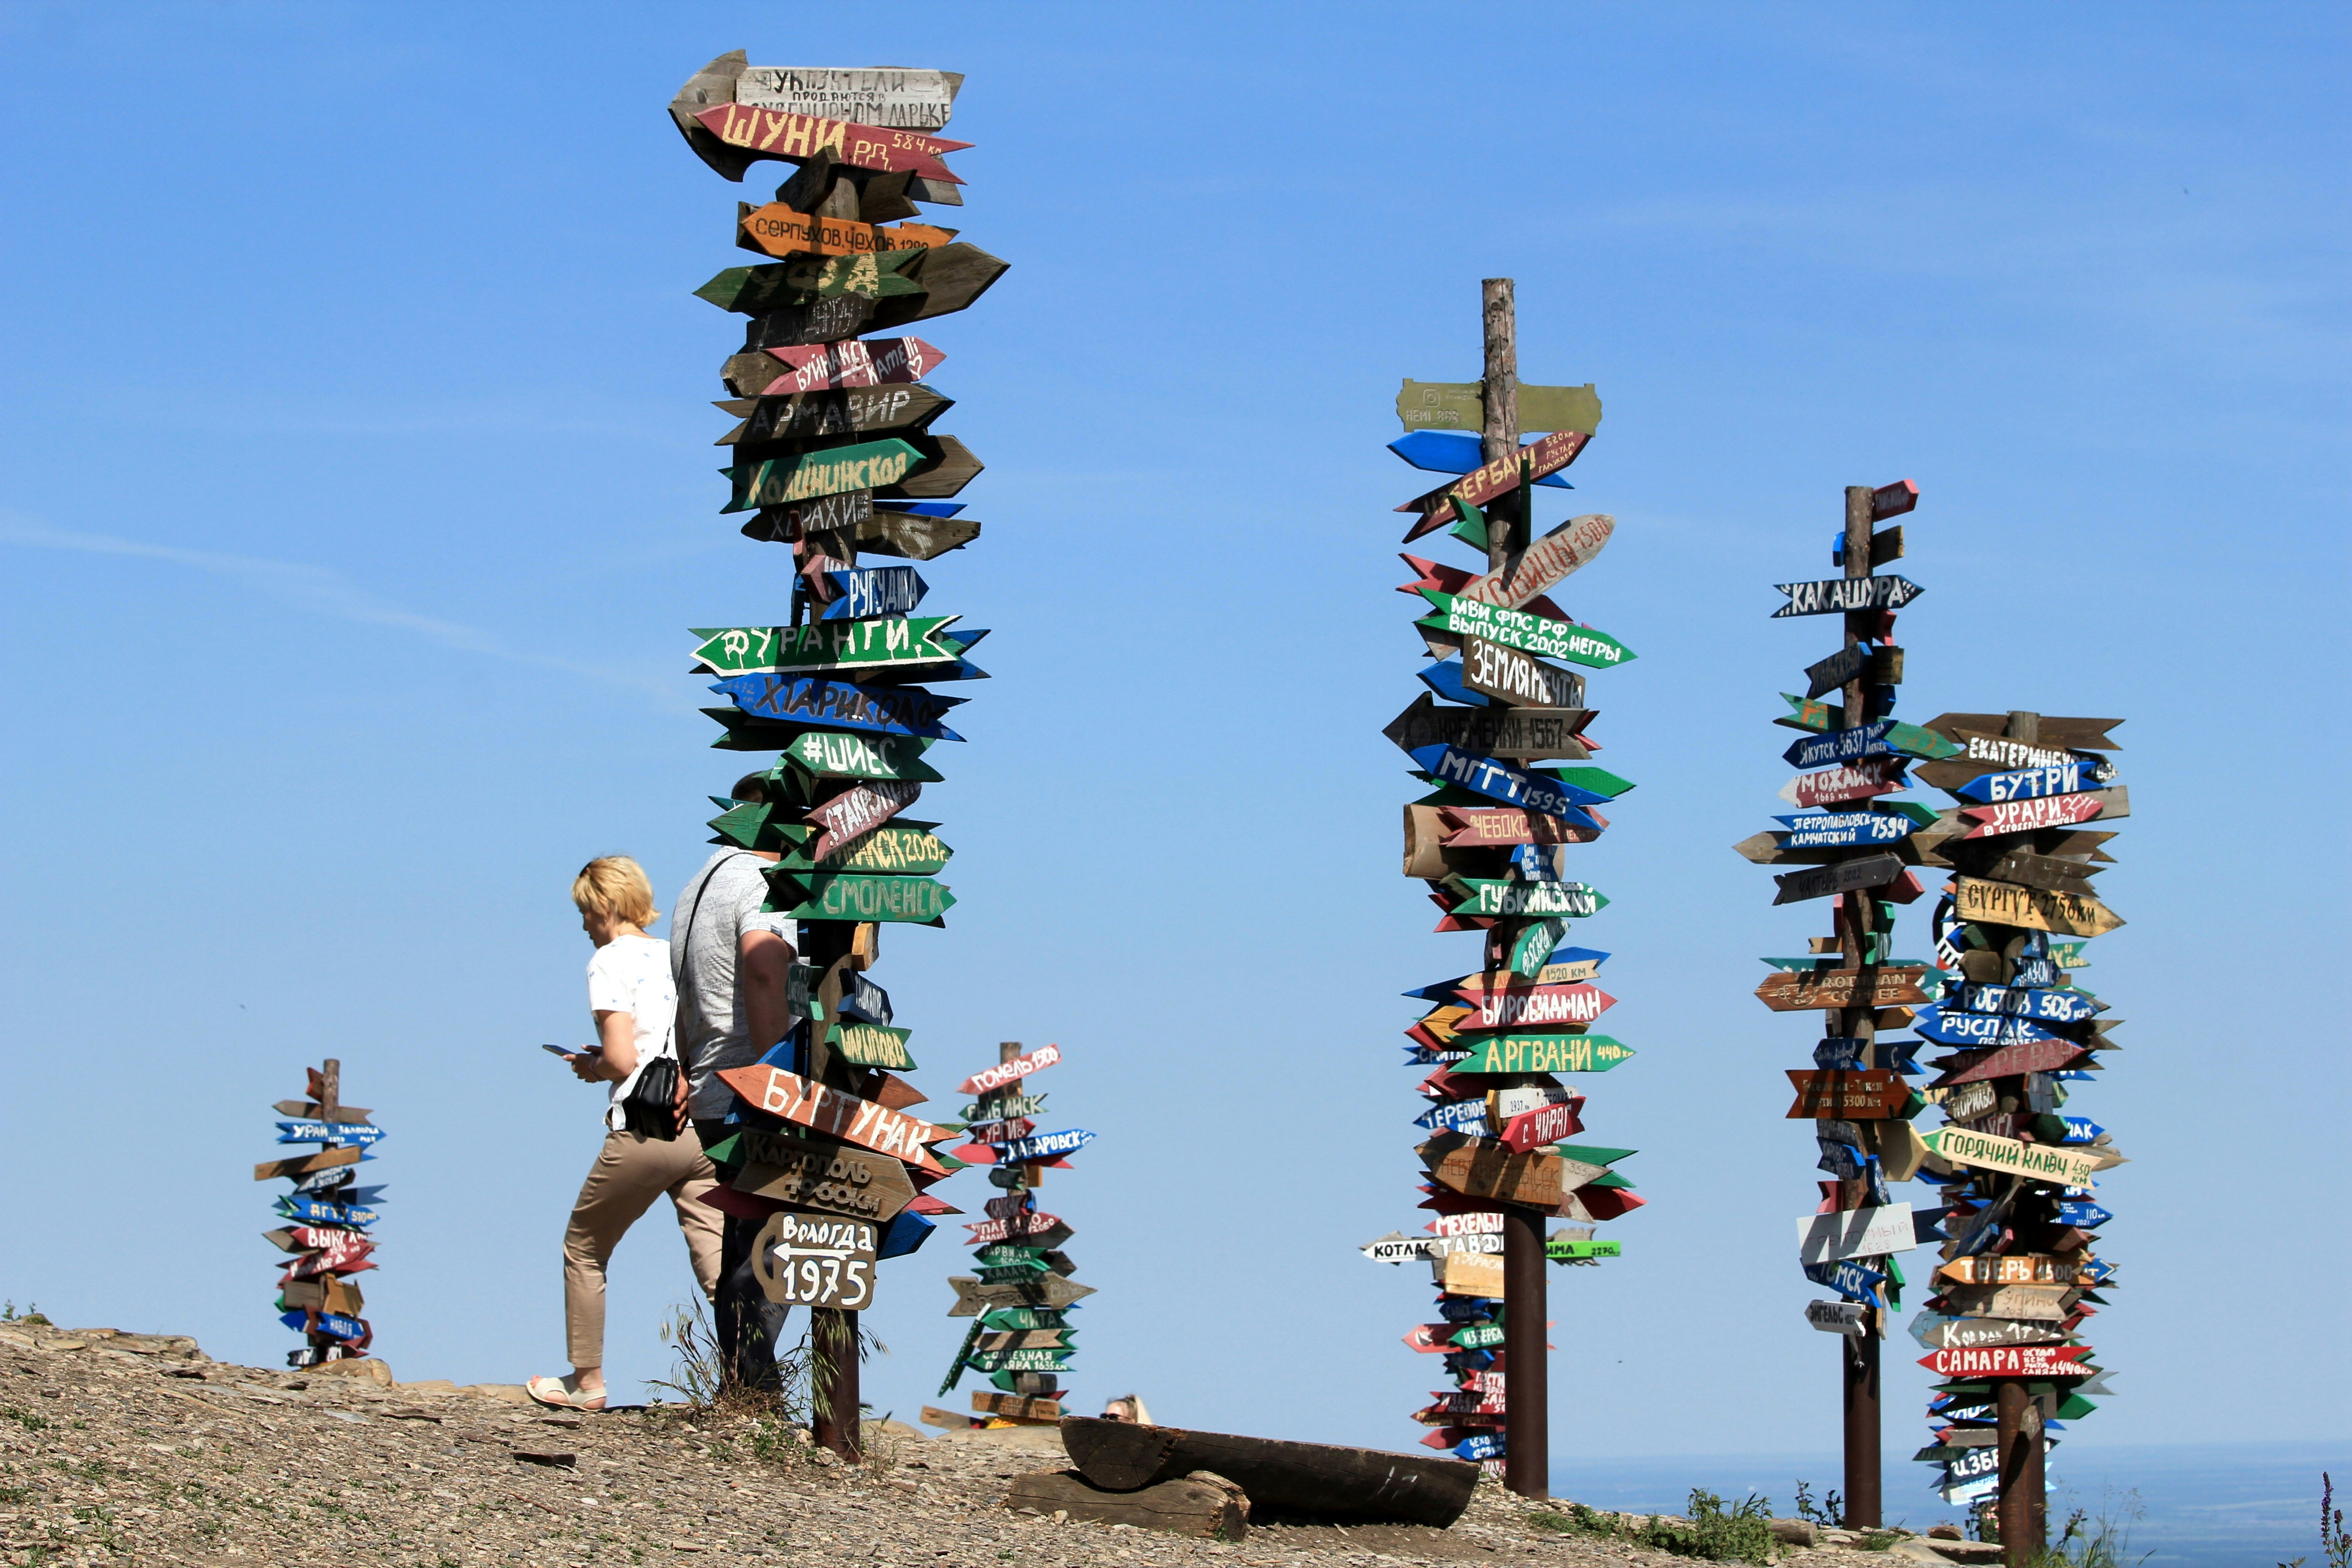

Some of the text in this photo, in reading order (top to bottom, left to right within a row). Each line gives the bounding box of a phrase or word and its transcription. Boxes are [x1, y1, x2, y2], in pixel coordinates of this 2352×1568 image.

[793, 92, 874, 102] ПРОДАЮТСЯ
[889, 103, 950, 127] ЛАРЬКЕ
[722, 105, 846, 158] ШУНИ
[892, 133, 926, 152] 584
[795, 341, 870, 391] БУЙНАКСК
[751, 390, 911, 433] АРМАВИР
[1545, 433, 1563, 448] 520
[1546, 441, 1575, 461] РУСТАМ
[1538, 451, 1574, 474] ГАДЖИЕВ
[1574, 516, 1611, 549] 1500
[849, 567, 918, 618] РУГУДЖА
[1451, 598, 1568, 639] МВИ ФПС РФ
[1449, 613, 1568, 659] ВЫПУСК 2002
[1569, 635, 1622, 662] НЕГРЫ
[1438, 715, 1564, 750] КРЕМЕНКИ 1567
[1799, 729, 1863, 765] ЯКУТСК 5637
[803, 733, 899, 776] #ШИЕС
[1801, 762, 1882, 793] МОЖАЙСК
[1990, 764, 2079, 802] БУТРИ
[1522, 786, 1570, 815] 1595
[1470, 812, 1561, 840] ЧЕБОКСАРЫ
[1791, 828, 1857, 847] КАМЧАТСКИЙ
[1871, 816, 1908, 840] 7594
[823, 879, 945, 915] СМОЛЕНСК
[1480, 884, 1597, 914] ГУБКИНСКИЙ
[1968, 883, 2035, 921] СУРГУТ
[1546, 968, 1568, 981] 1520
[1964, 985, 2032, 1015] РОСТОВ
[2039, 995, 2078, 1022] 505
[1032, 1046, 1059, 1070] 1500
[1485, 1039, 1592, 1073] АРГВАНИ
[1597, 1044, 1622, 1061] 440
[763, 1067, 935, 1164] БУРТУНАЙ
[966, 1094, 1045, 1122] РЫБИНСК
[1510, 1100, 1523, 1112] 2937
[1843, 1095, 1867, 1107] 5300
[1535, 1104, 1572, 1142] ЧИРАГ
[1008, 1130, 1082, 1161] ХАБАРОВСК
[1943, 1132, 2091, 1177] ГОРЯЧИЙ КЛЮЧ 430
[2086, 1208, 2097, 1220] 110
[984, 1246, 1031, 1259] БАРВИХА
[1591, 1247, 1614, 1256] 2270
[782, 1259, 868, 1305] 1975
[1960, 1255, 2073, 1282] ТВЕРЬ 1500
[1019, 1311, 1058, 1328] ЧИТА
[1810, 1304, 1844, 1324] ЭНГЕЛЬС
[985, 1360, 1031, 1370] ПОЛЯНА
[1034, 1360, 1054, 1370] 1635
[1936, 1349, 2019, 1373] САМАРА
